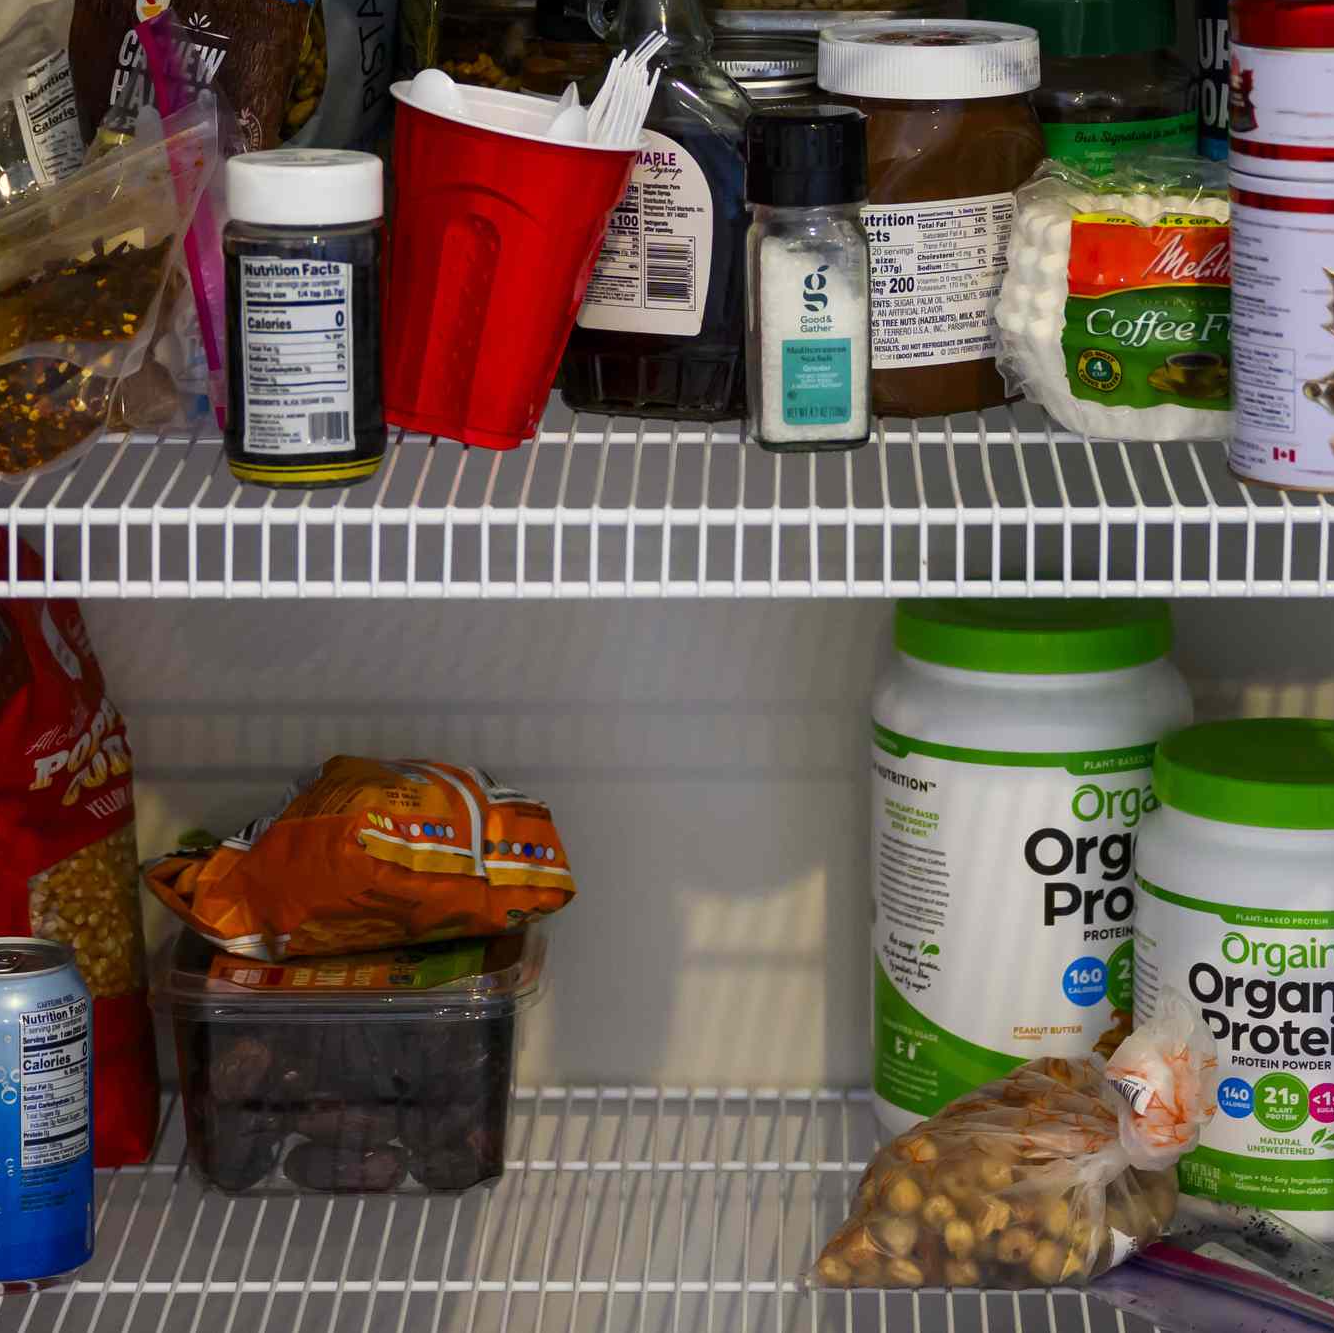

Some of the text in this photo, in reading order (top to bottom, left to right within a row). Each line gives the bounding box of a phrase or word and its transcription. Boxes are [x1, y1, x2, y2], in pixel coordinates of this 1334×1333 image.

[618, 215, 639, 227] 100
[883, 247, 914, 257] servings
[917, 252, 955, 262] Cholesterol
[875, 256, 897, 266] size:
[244, 262, 341, 277] Nutrition Facts
[880, 264, 903, 276] (37g)
[917, 264, 942, 272] Sodium
[888, 275, 915, 294] 200
[247, 309, 345, 331] Calories 0
[800, 315, 826, 325] Good
[800, 324, 832, 334] Gather
[1086, 307, 1195, 348] Coffee
[1235, 913, 1330, 926] PLANT-BASED PROTEIN
[1083, 926, 1134, 942] PROTEIN
[1069, 969, 1103, 986] 160
[22, 1007, 67, 1027] Nutrition
[1013, 1024, 1083, 1037] PEANUT BUTTER
[22, 1052, 71, 1072] Calories
[1231, 1055, 1332, 1071] PROTEIN POWDER
[1221, 1087, 1250, 1101] 140
[1263, 1085, 1299, 1106] 21g
[1268, 1105, 1295, 1114] PLANT
[1259, 1136, 1301, 1148] NATURAL
[1247, 1144, 1315, 1156] UNSWEETENED
